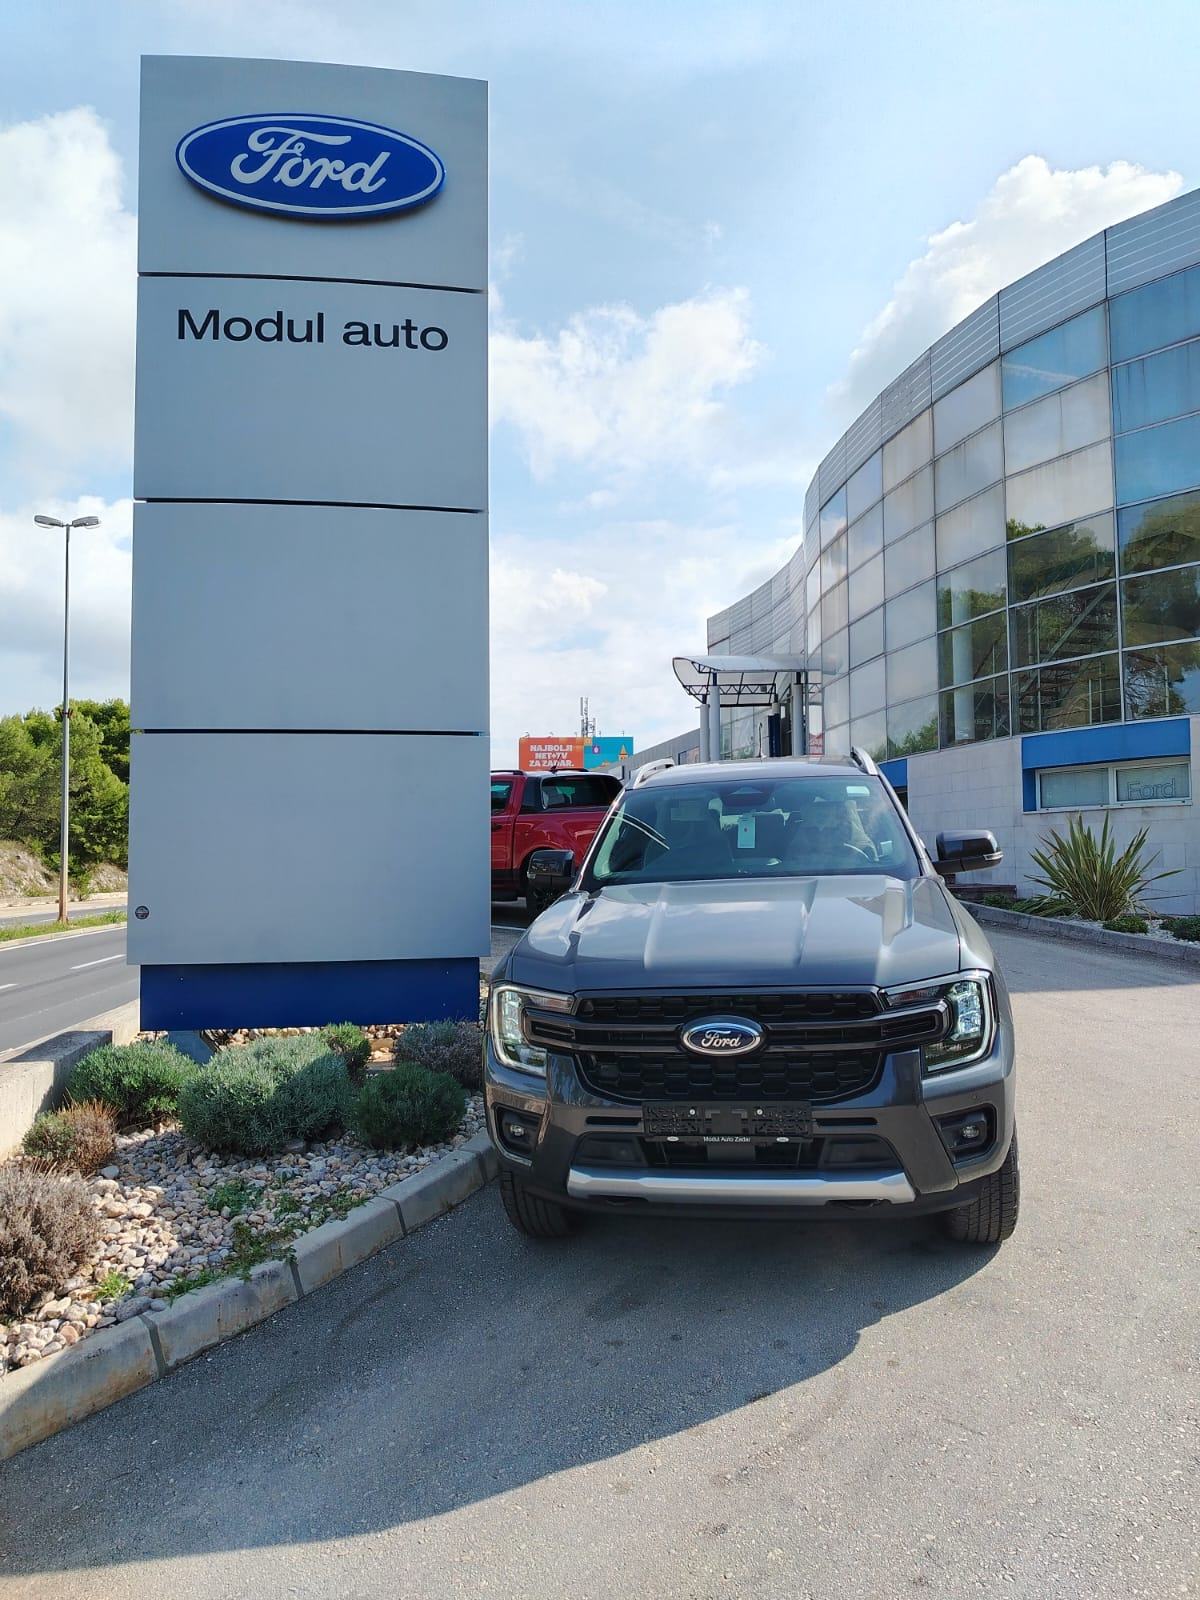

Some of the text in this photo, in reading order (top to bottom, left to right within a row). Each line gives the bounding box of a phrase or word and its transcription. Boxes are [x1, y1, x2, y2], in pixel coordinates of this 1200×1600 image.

[230, 126, 391, 194] Ford
[177, 309, 448, 351] Modul auto
[530, 744, 572, 752] NAJBOLJI
[1127, 777, 1176, 800] Ford
[701, 1029, 742, 1048] Ford
[703, 1135, 720, 1143] Modul
[720, 1135, 734, 1143] Auto
